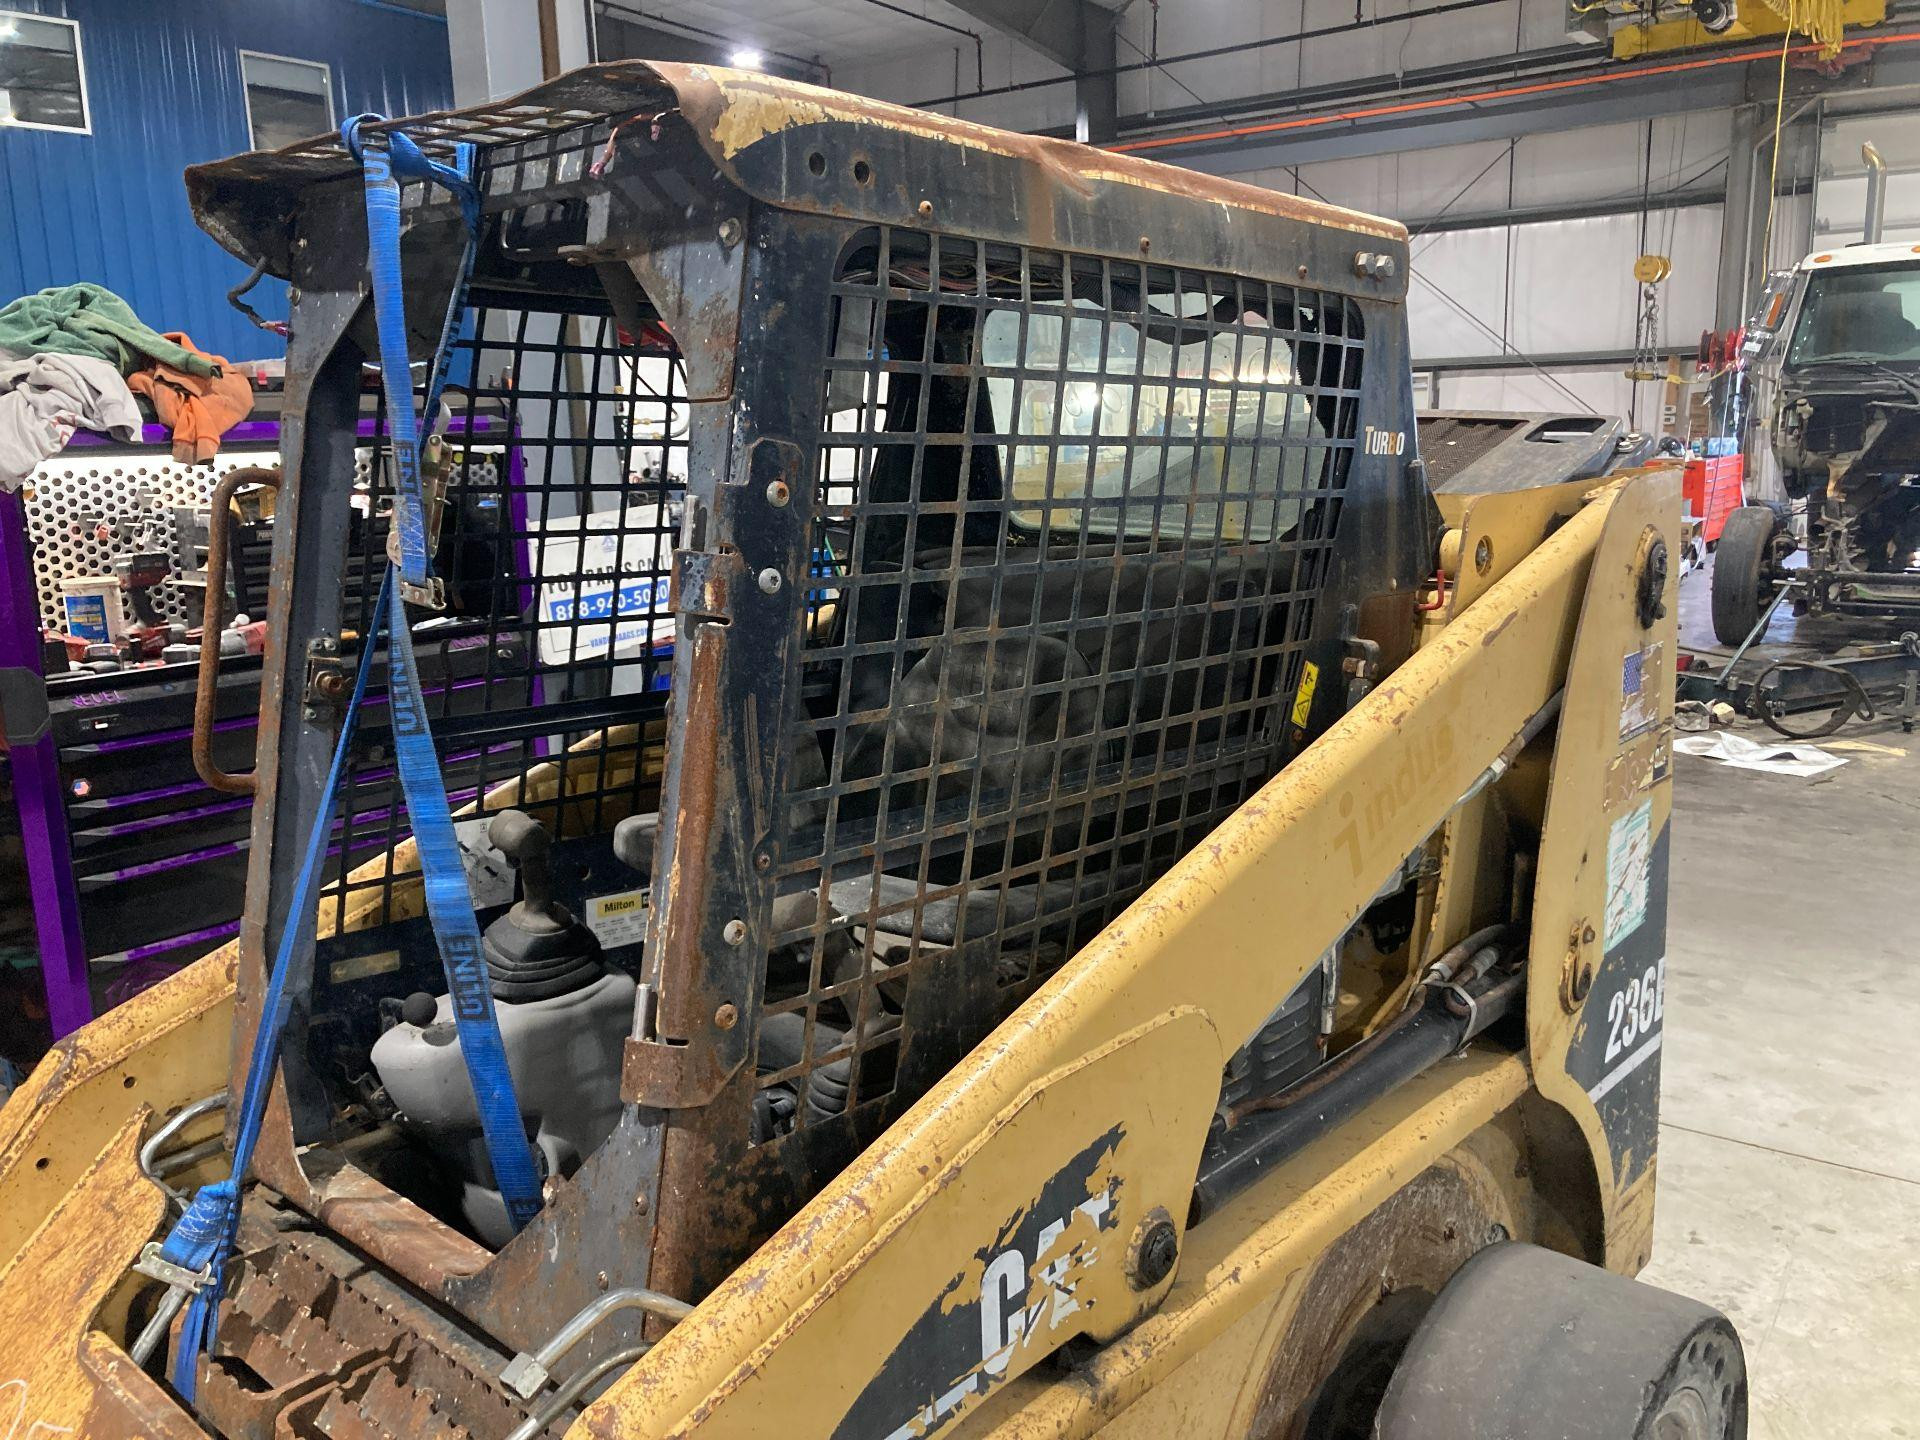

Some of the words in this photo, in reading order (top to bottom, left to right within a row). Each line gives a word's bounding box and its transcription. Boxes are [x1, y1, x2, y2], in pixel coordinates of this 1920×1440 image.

[1364, 425, 1405, 456] TURBO
[549, 571, 577, 594] FO
[587, 561, 632, 588] PARS
[604, 899, 635, 913] Milton
[450, 939, 484, 1016] ULINE
